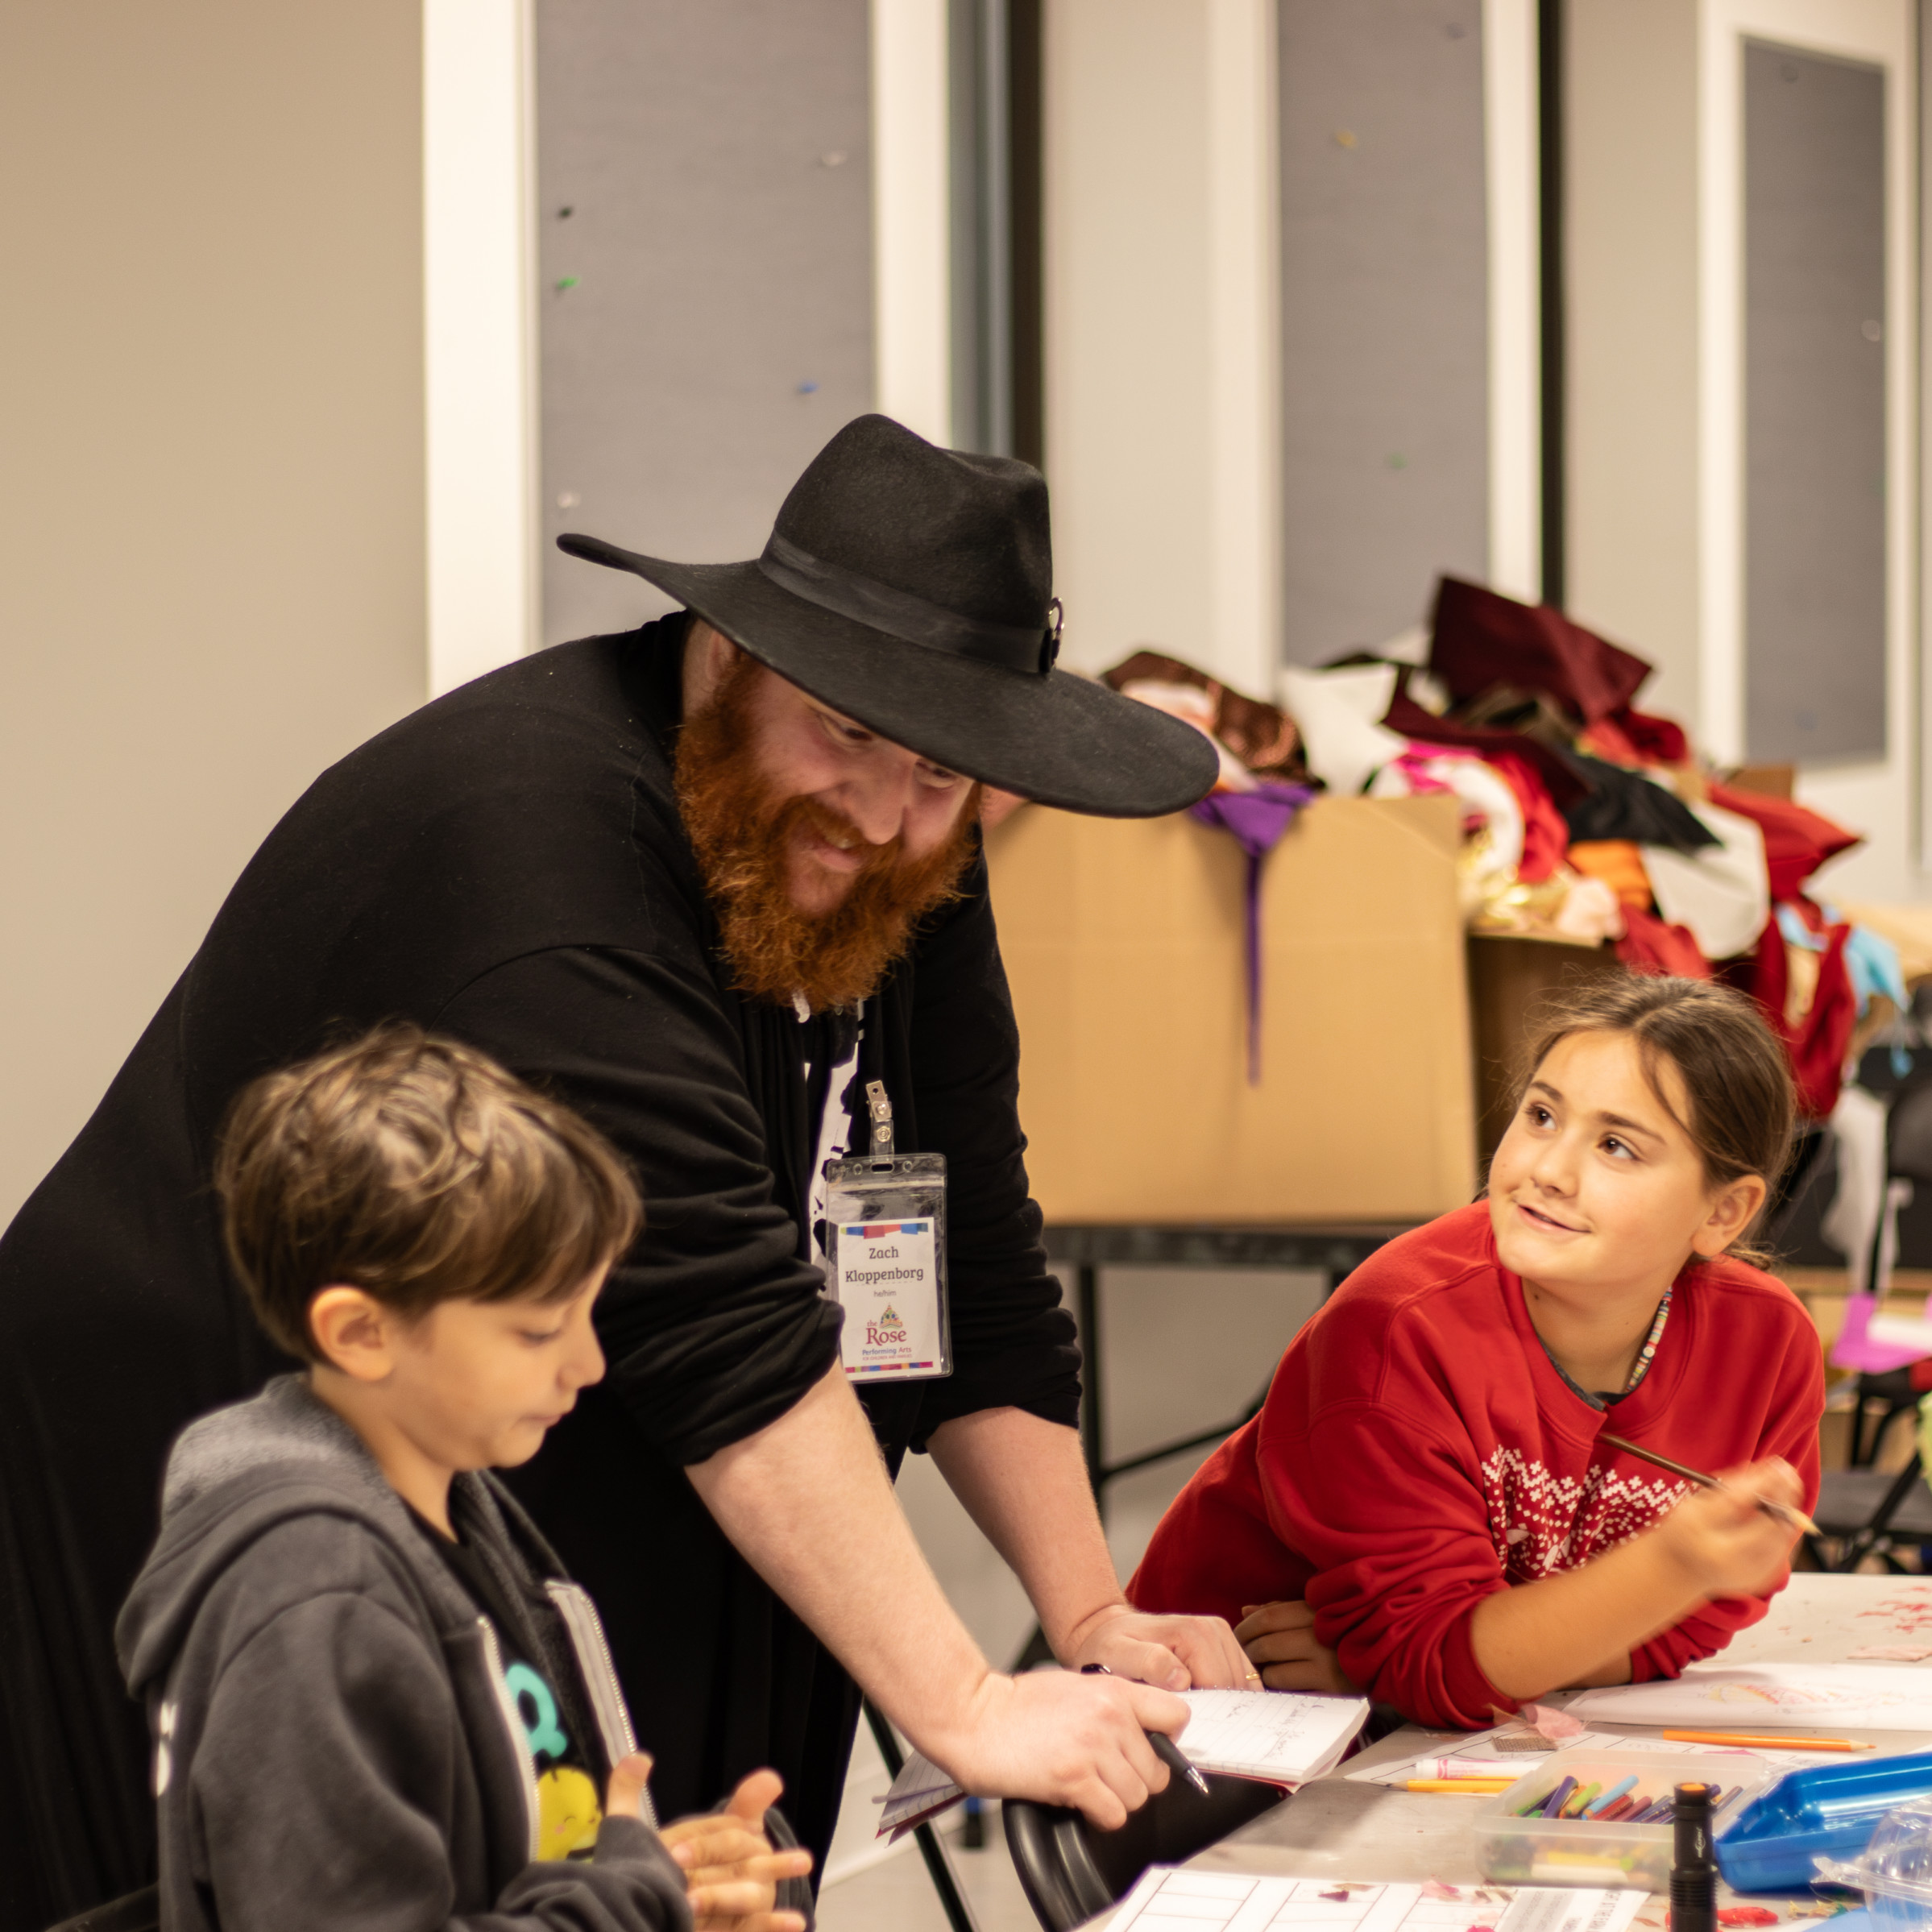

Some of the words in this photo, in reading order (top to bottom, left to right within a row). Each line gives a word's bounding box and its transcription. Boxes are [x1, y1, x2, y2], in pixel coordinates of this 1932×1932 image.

[869, 1246, 899, 1259] Zach
[845, 1267, 924, 1284] Kloppenborg
[865, 1327, 907, 1346] Rose
